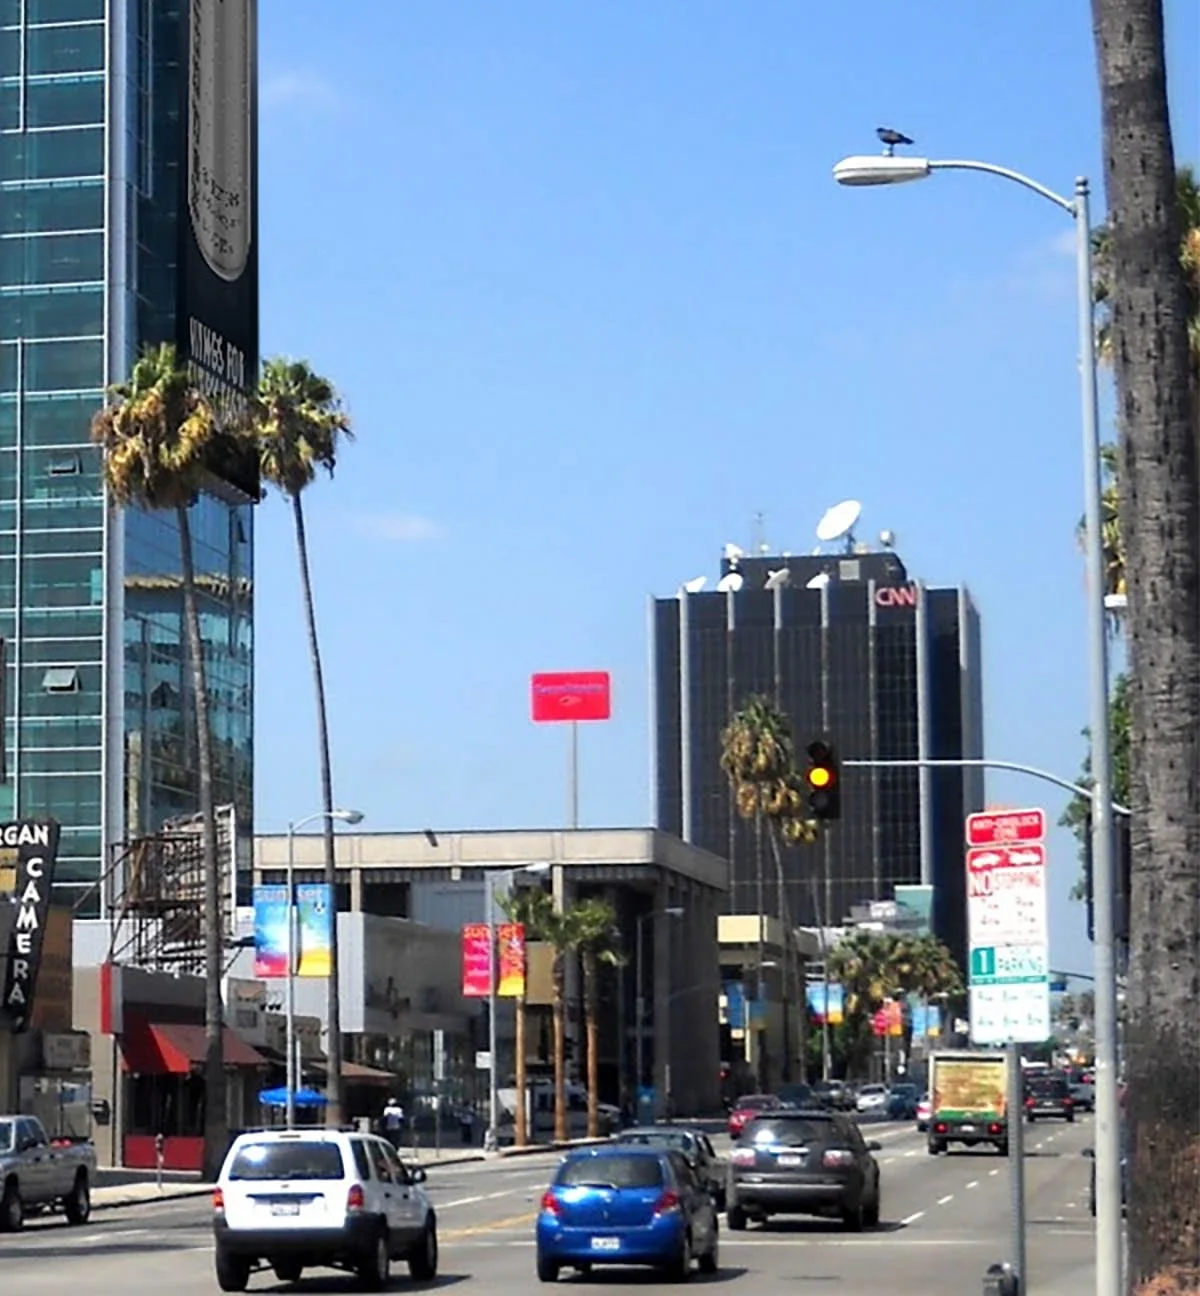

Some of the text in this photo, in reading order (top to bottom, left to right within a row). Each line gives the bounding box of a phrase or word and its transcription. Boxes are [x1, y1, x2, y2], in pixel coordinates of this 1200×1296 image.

[876, 587, 915, 605] CNN
[968, 870, 994, 896] NO
[7, 857, 44, 1005] CAMERA
